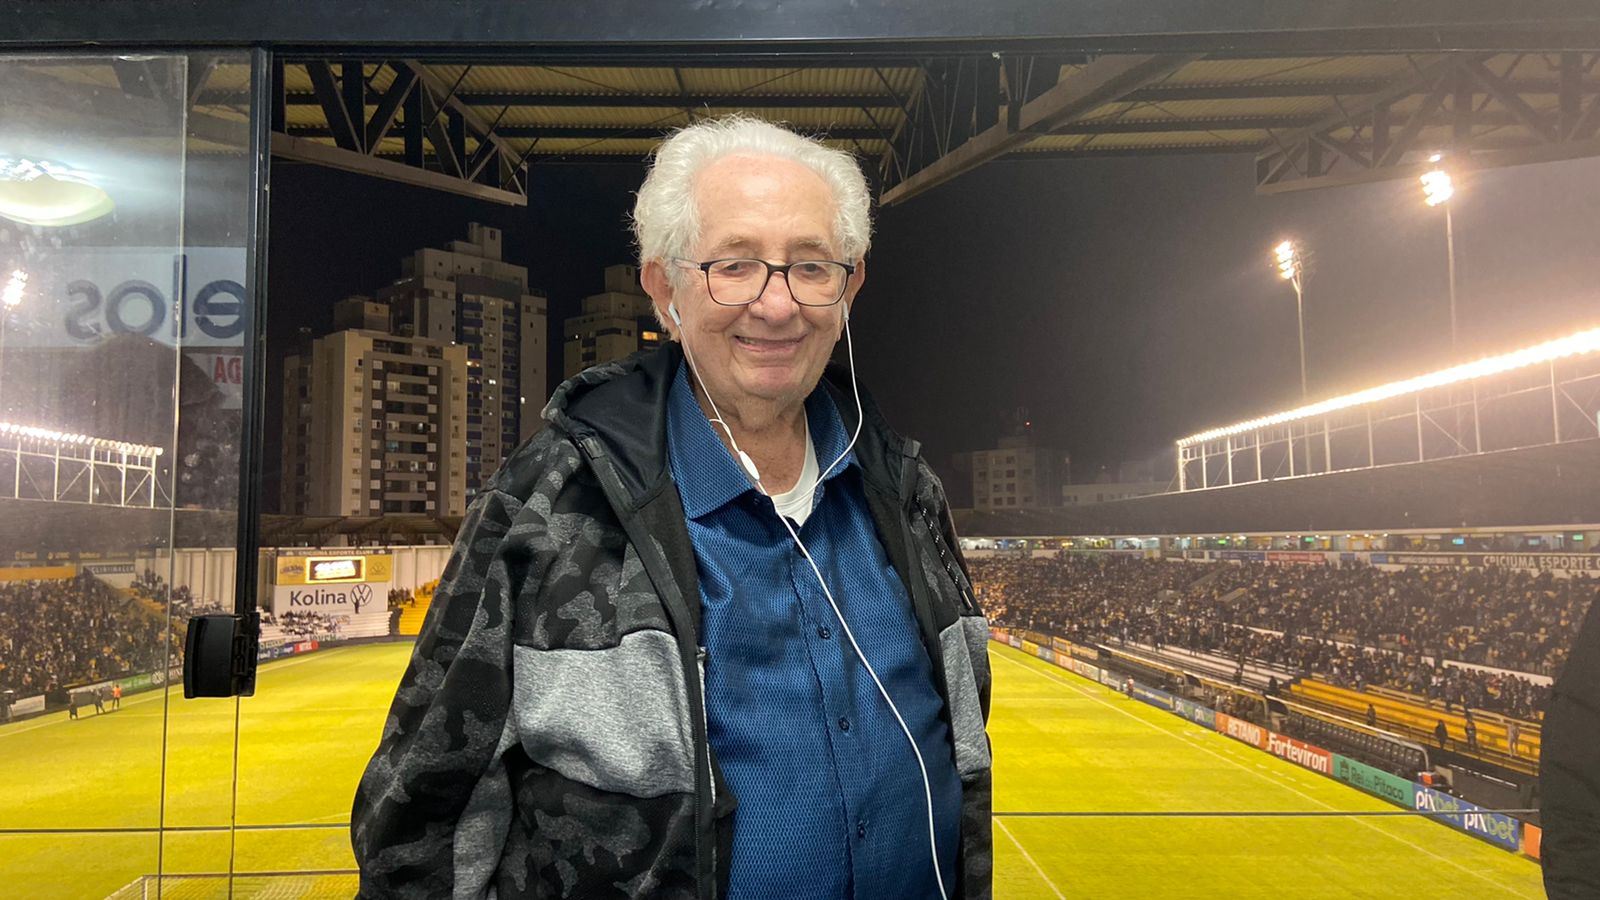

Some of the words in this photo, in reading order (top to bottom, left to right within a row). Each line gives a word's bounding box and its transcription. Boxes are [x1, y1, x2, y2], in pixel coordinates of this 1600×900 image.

[1540, 556, 1592, 569] ESPORTE
[290, 589, 347, 606] Kolina
[1227, 717, 1261, 746] BETANO
[1267, 732, 1328, 772] Forteviron
[1416, 787, 1460, 822] pixbet
[1464, 807, 1516, 844] pixbet
